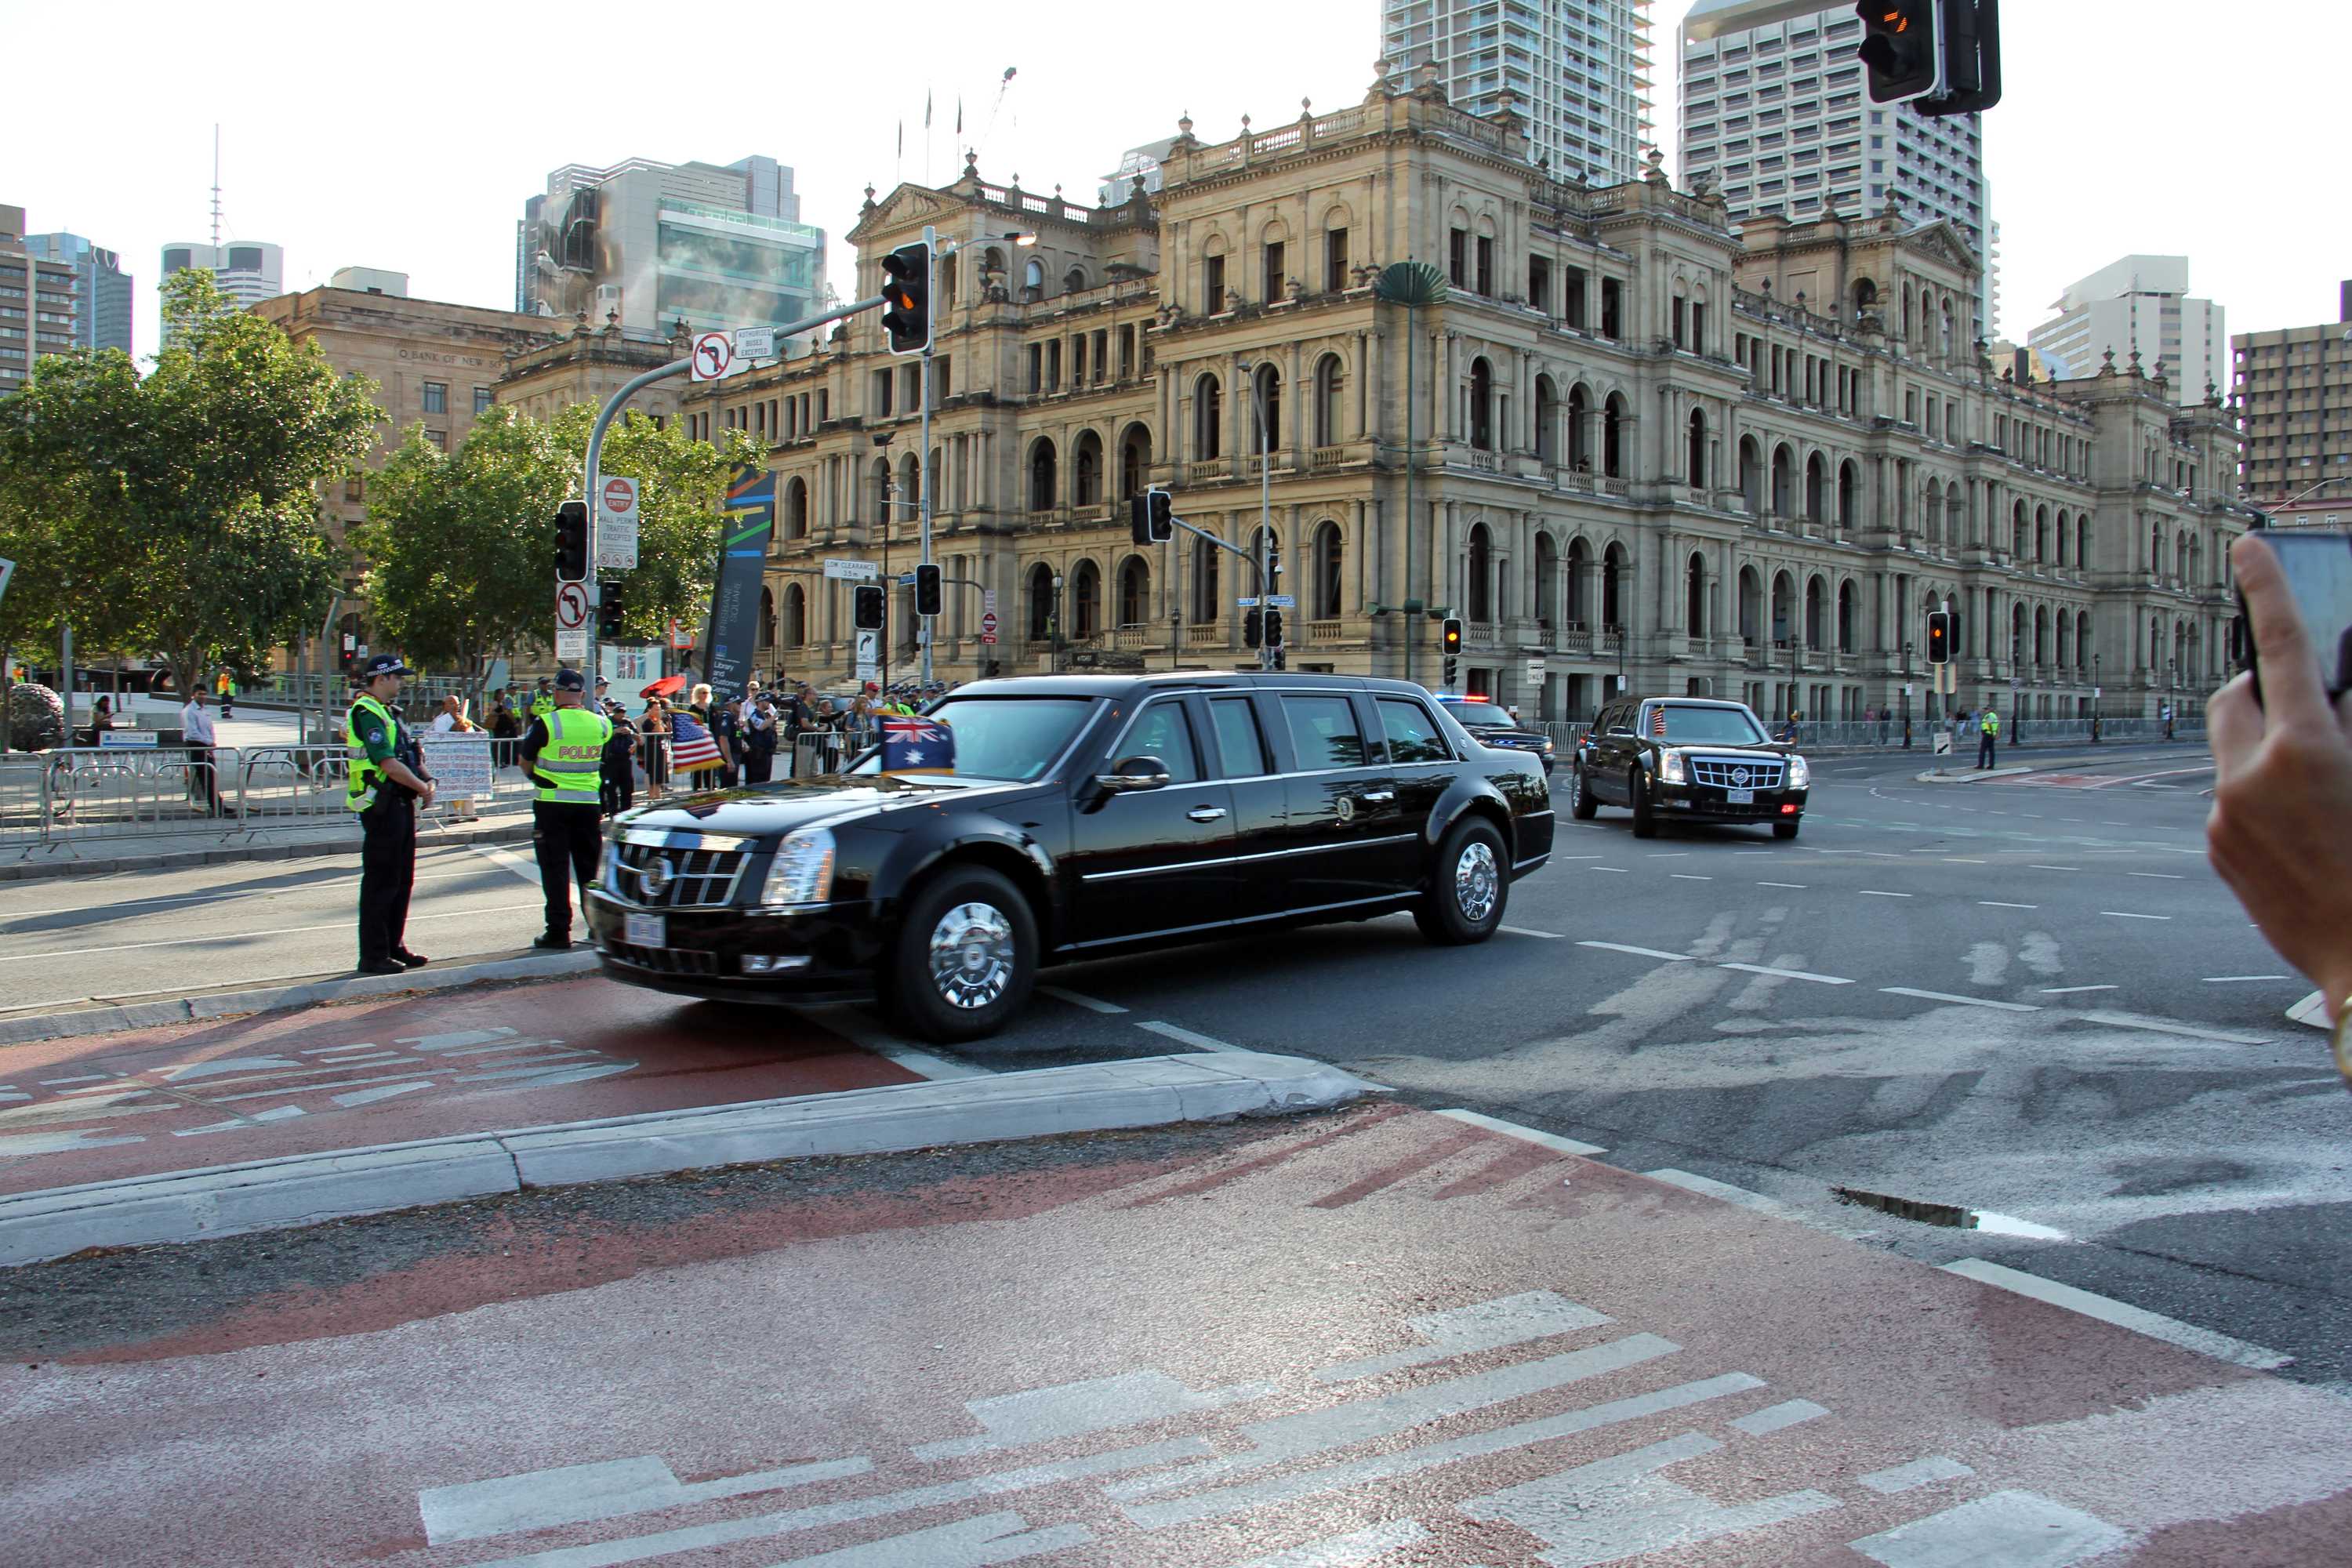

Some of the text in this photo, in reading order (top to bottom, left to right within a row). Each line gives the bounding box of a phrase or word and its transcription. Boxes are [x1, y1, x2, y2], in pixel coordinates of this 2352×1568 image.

[741, 347, 768, 356] EXCEPTED
[412, 351, 439, 361] BANK
[443, 355, 457, 364] OF
[608, 499, 629, 508] ENTRY
[616, 517, 637, 525] PERMIT
[606, 524, 630, 533] TRAFFIC
[603, 532, 631, 542] EXCEPTED
[841, 562, 875, 571] CLEARANCE
[714, 661, 735, 672] Library
[712, 677, 741, 688] Customer
